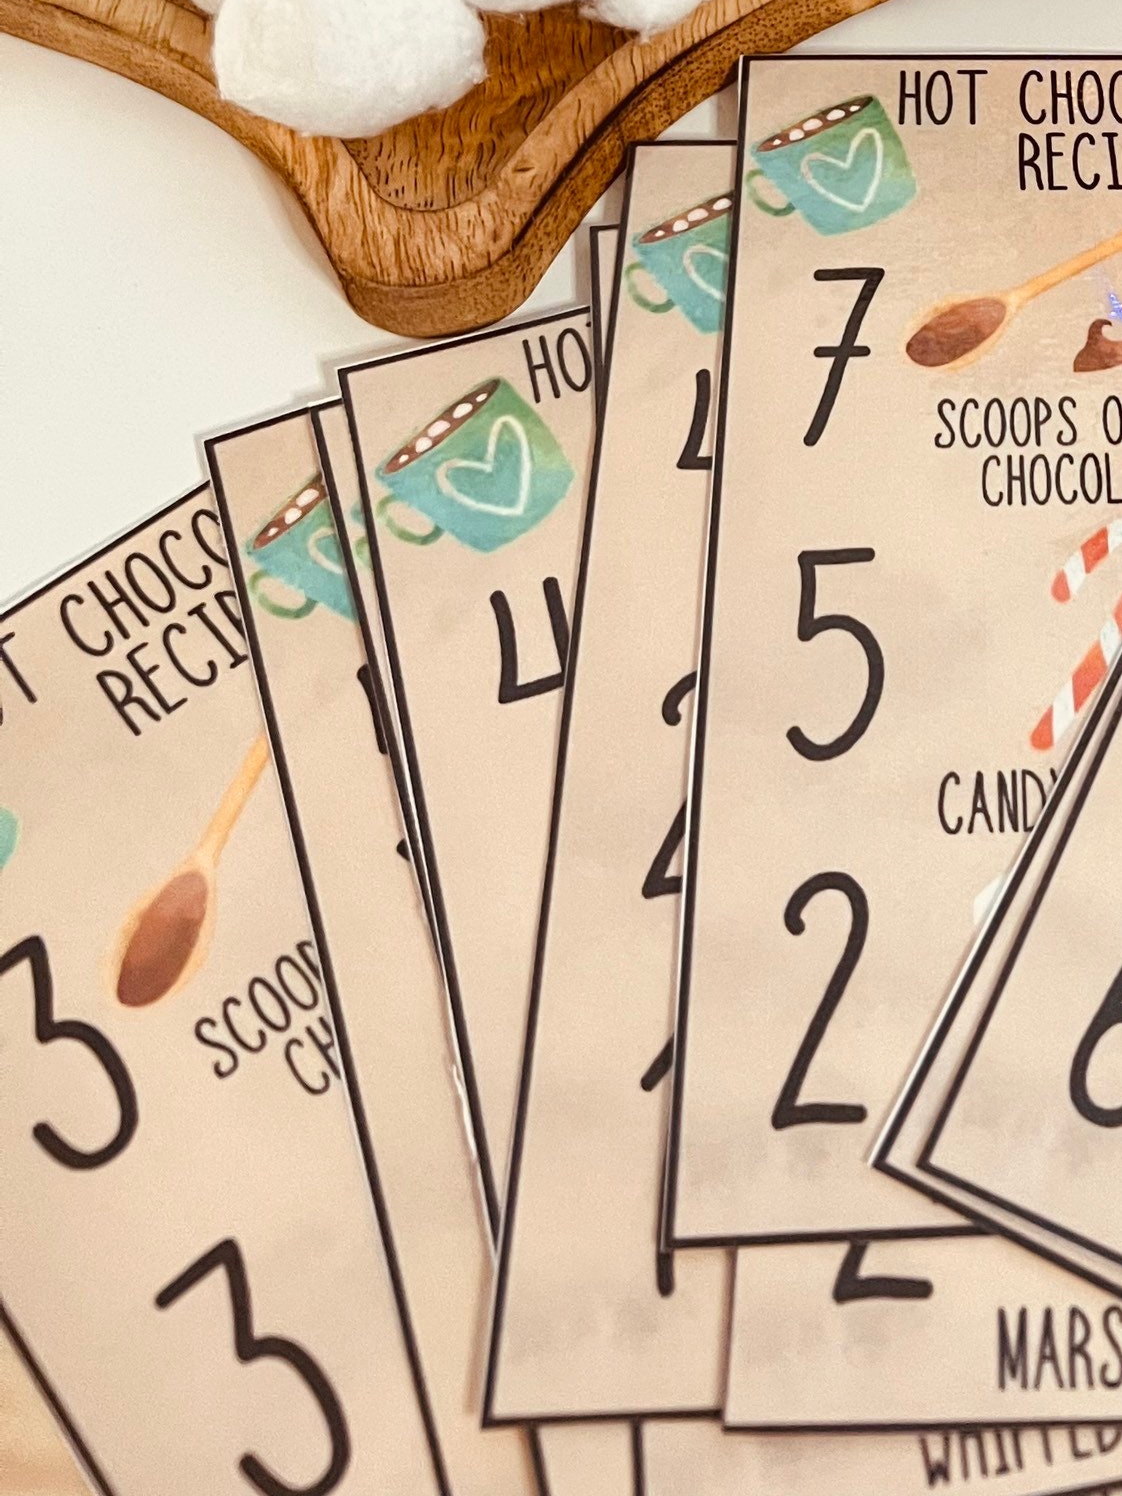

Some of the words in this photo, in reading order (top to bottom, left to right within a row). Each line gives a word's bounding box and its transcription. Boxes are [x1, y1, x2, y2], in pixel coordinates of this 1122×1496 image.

[898, 70, 989, 126] HOT
[522, 321, 593, 403] HO
[803, 267, 885, 447] 7
[934, 397, 1078, 449] SCOOPS
[786, 547, 885, 761] 5
[937, 768, 1060, 835] CAND
[0, 934, 139, 1171] 3
[766, 871, 870, 1130] 2
[155, 1237, 351, 1496] 3
